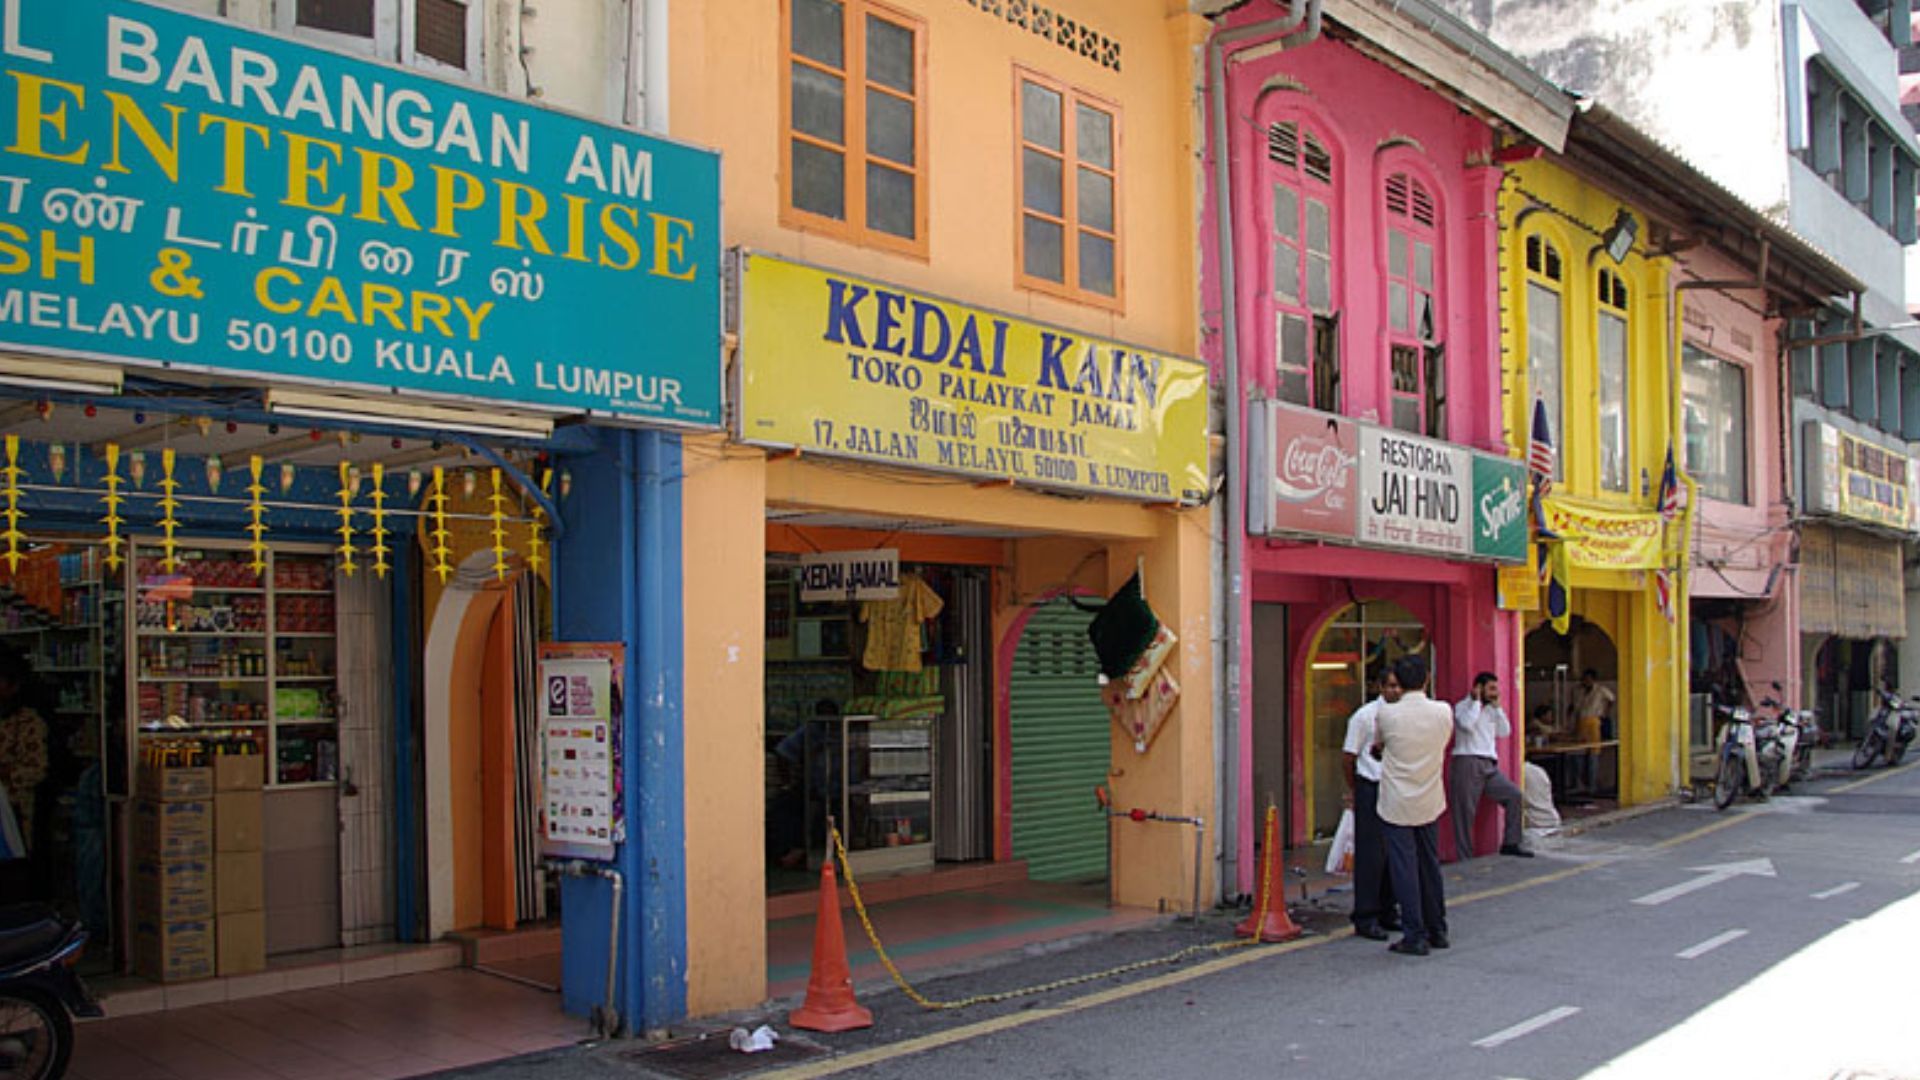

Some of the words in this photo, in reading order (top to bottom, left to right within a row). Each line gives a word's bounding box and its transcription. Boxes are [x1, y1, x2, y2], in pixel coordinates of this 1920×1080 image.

[107, 14, 530, 173] BARANGAN
[566, 135, 654, 201] AM
[5, 69, 698, 282] ENTERPRISE
[150, 247, 205, 299] &
[254, 266, 495, 341] CARRY
[227, 318, 353, 364] 50100
[375, 339, 515, 386] KUALA
[535, 361, 683, 406] LUMPUR
[823, 278, 1009, 378] KEDAI
[1037, 331, 1160, 410] KAIN
[848, 353, 923, 391] TOKO
[940, 374, 1055, 417] PALAYKAT
[1070, 397, 1137, 431] JAMAL
[846, 427, 918, 460] JALAN
[1035, 455, 1077, 482] 50100
[1381, 437, 1453, 476] RESTORAN
[1372, 472, 1408, 515] JAI
[1415, 475, 1459, 523] HIND
[1481, 488, 1523, 540] Sprite
[800, 563, 844, 591] KEDAI
